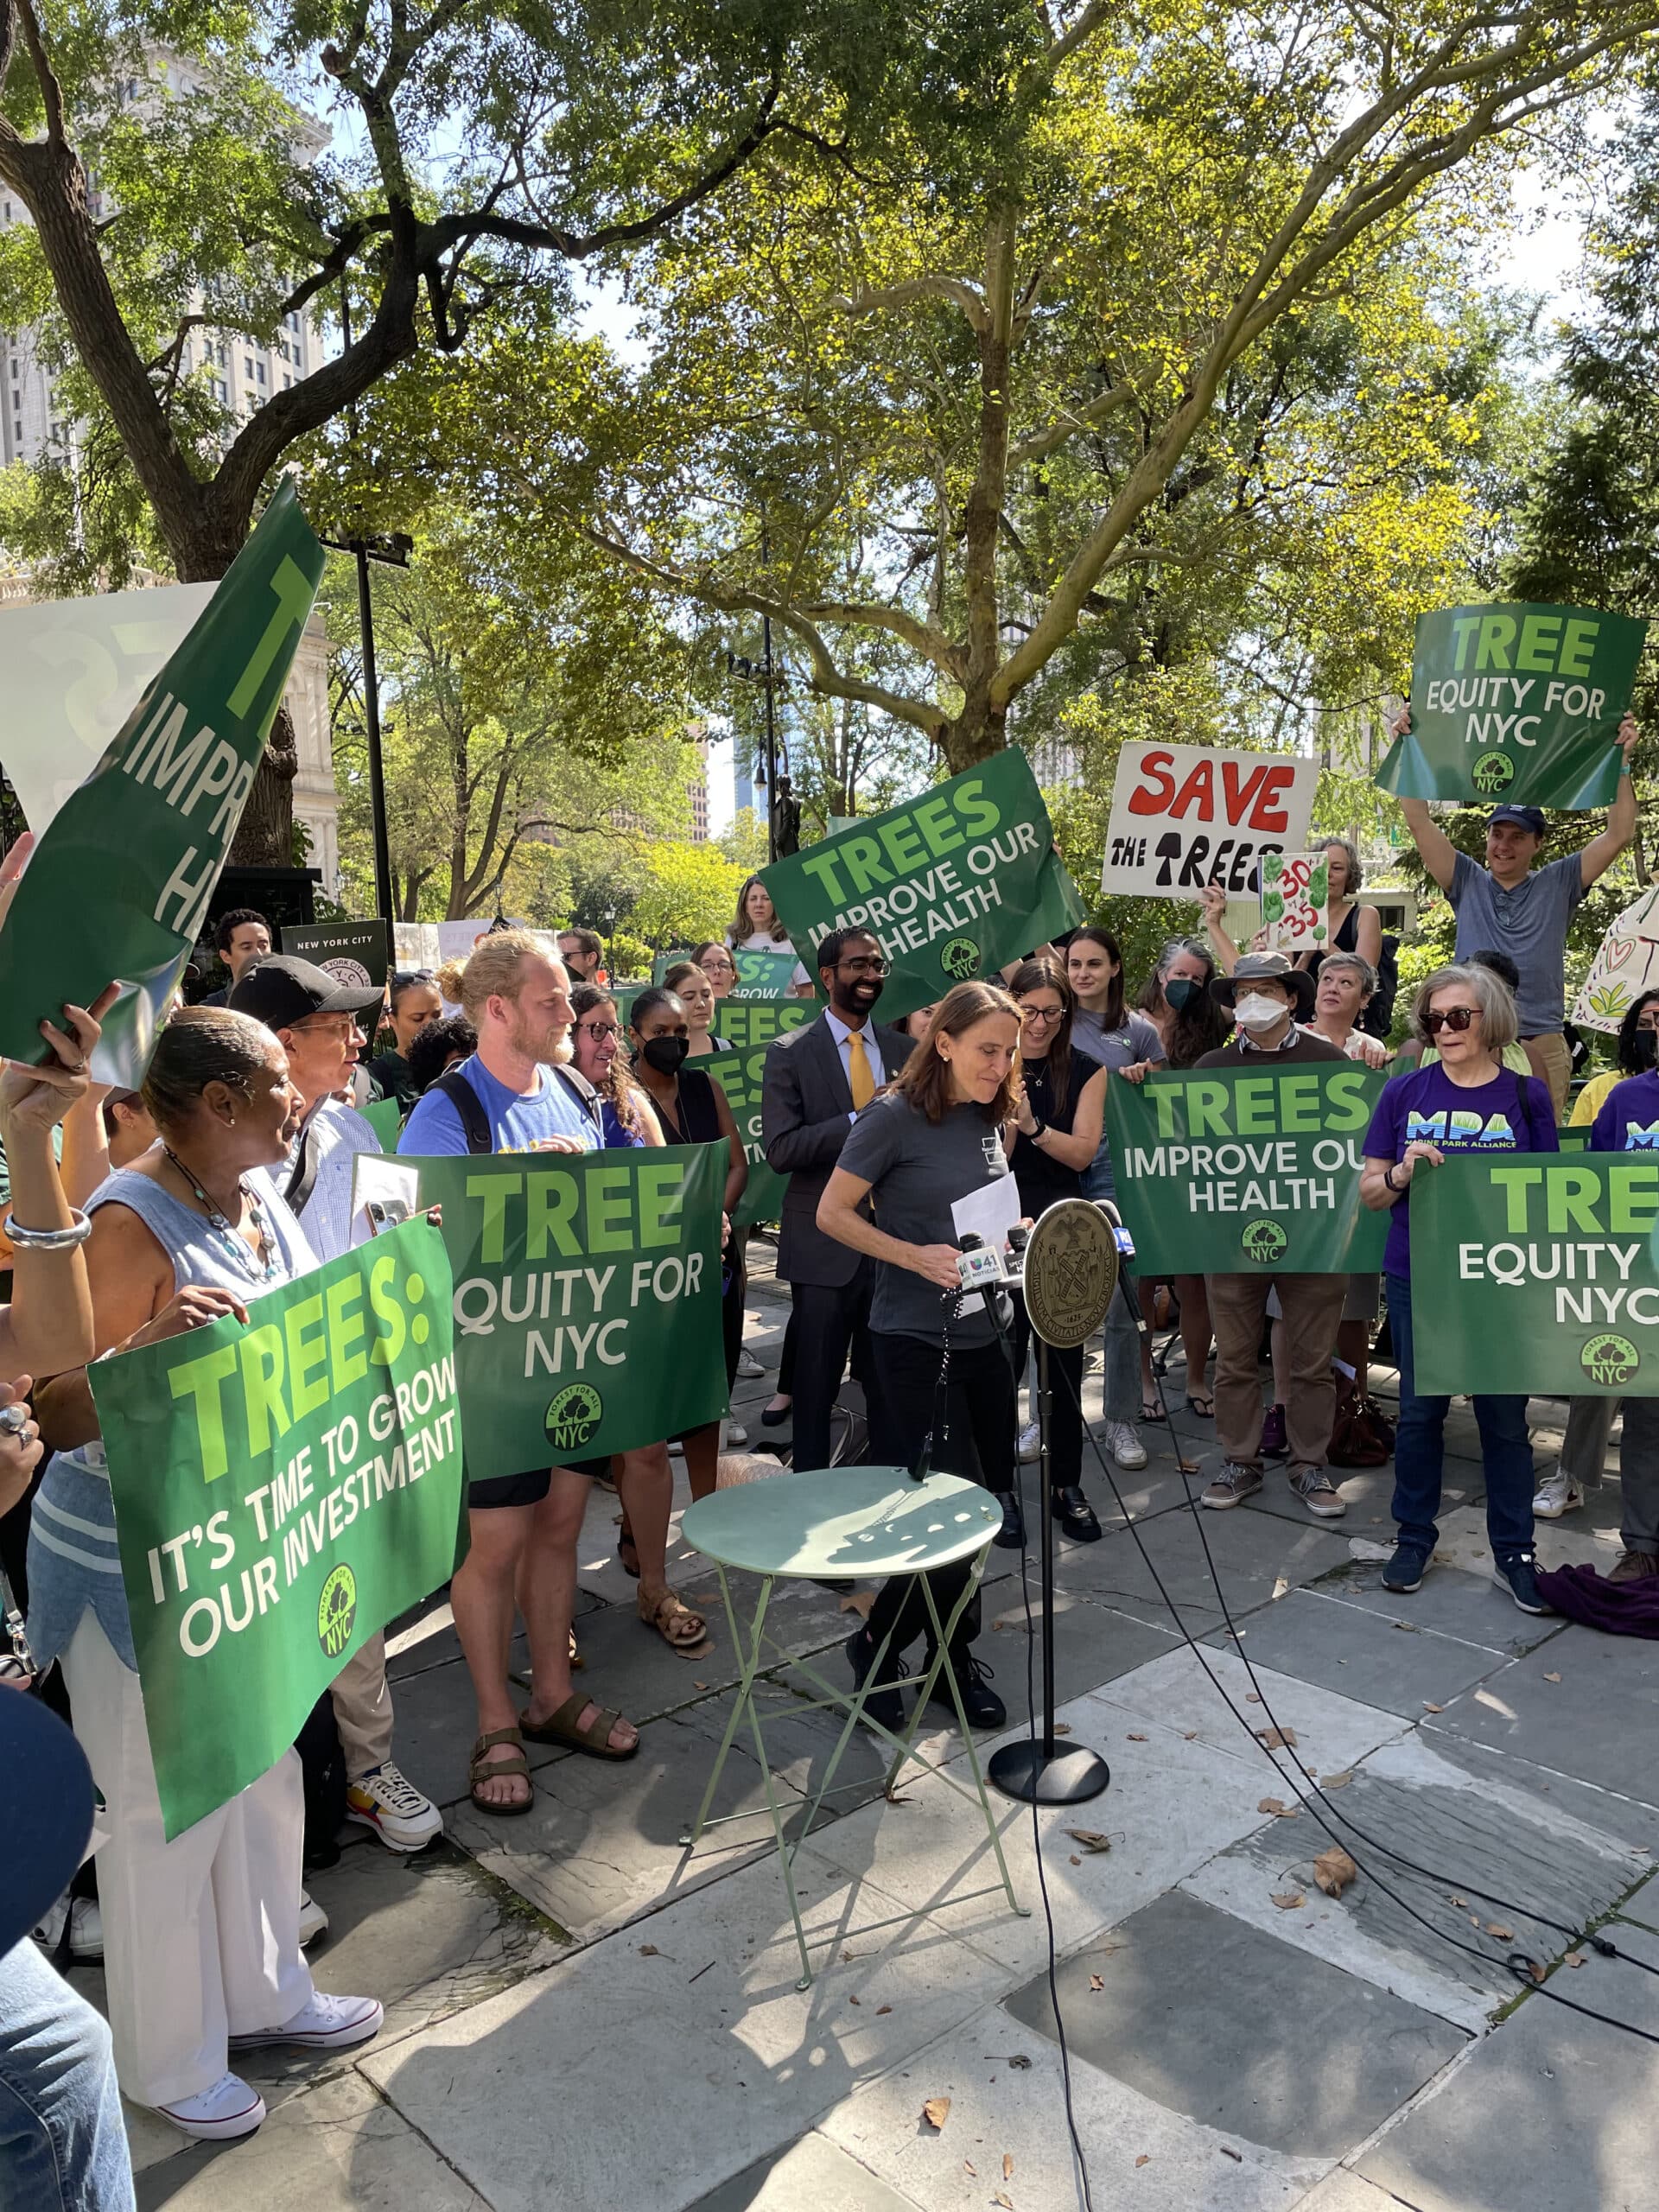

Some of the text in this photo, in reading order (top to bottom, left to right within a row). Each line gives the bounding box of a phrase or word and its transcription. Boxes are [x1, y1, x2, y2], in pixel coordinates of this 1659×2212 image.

[1452, 614, 1600, 677] TREE
[1426, 677, 1605, 720] EQUITY FOR
[1465, 713, 1541, 747] NYC
[122, 691, 255, 845] IMPR
[1477, 778, 1503, 793] NYC
[1128, 751, 1295, 833] SAVE
[802, 779, 1001, 906] TREES
[1110, 836, 1147, 867] THE
[807, 822, 1040, 950] IMPROVE OUR
[877, 878, 1003, 962] HEALTH
[297, 935, 372, 950] NEW YORK CITY
[952, 959, 977, 978] NYC
[1143, 1071, 1370, 1139] TREES
[1407, 1110, 1516, 1141] MPA
[1124, 1139, 1365, 1178] IMPROVE OU
[466, 1163, 684, 1264] TREE
[1188, 1178, 1335, 1212] HEALTH
[1490, 1166, 1659, 1234] TRE
[983, 1255, 997, 1267] 41
[1250, 1247, 1279, 1262] NYC
[1459, 1243, 1642, 1286] EQUITY
[453, 1252, 704, 1337] QUITY FOR
[1555, 1287, 1659, 1325] NYC
[168, 1255, 429, 1484] TREES:
[524, 1319, 629, 1377] NYC
[1592, 1366, 1627, 1384] NYC
[245, 1445, 315, 1542] TIME
[321, 1415, 359, 1478] TO
[367, 1352, 455, 1442] GROW
[555, 1423, 589, 1449] NYC
[180, 1408, 455, 1658] OUR INVESTMENT
[327, 1611, 351, 1655] NYC
